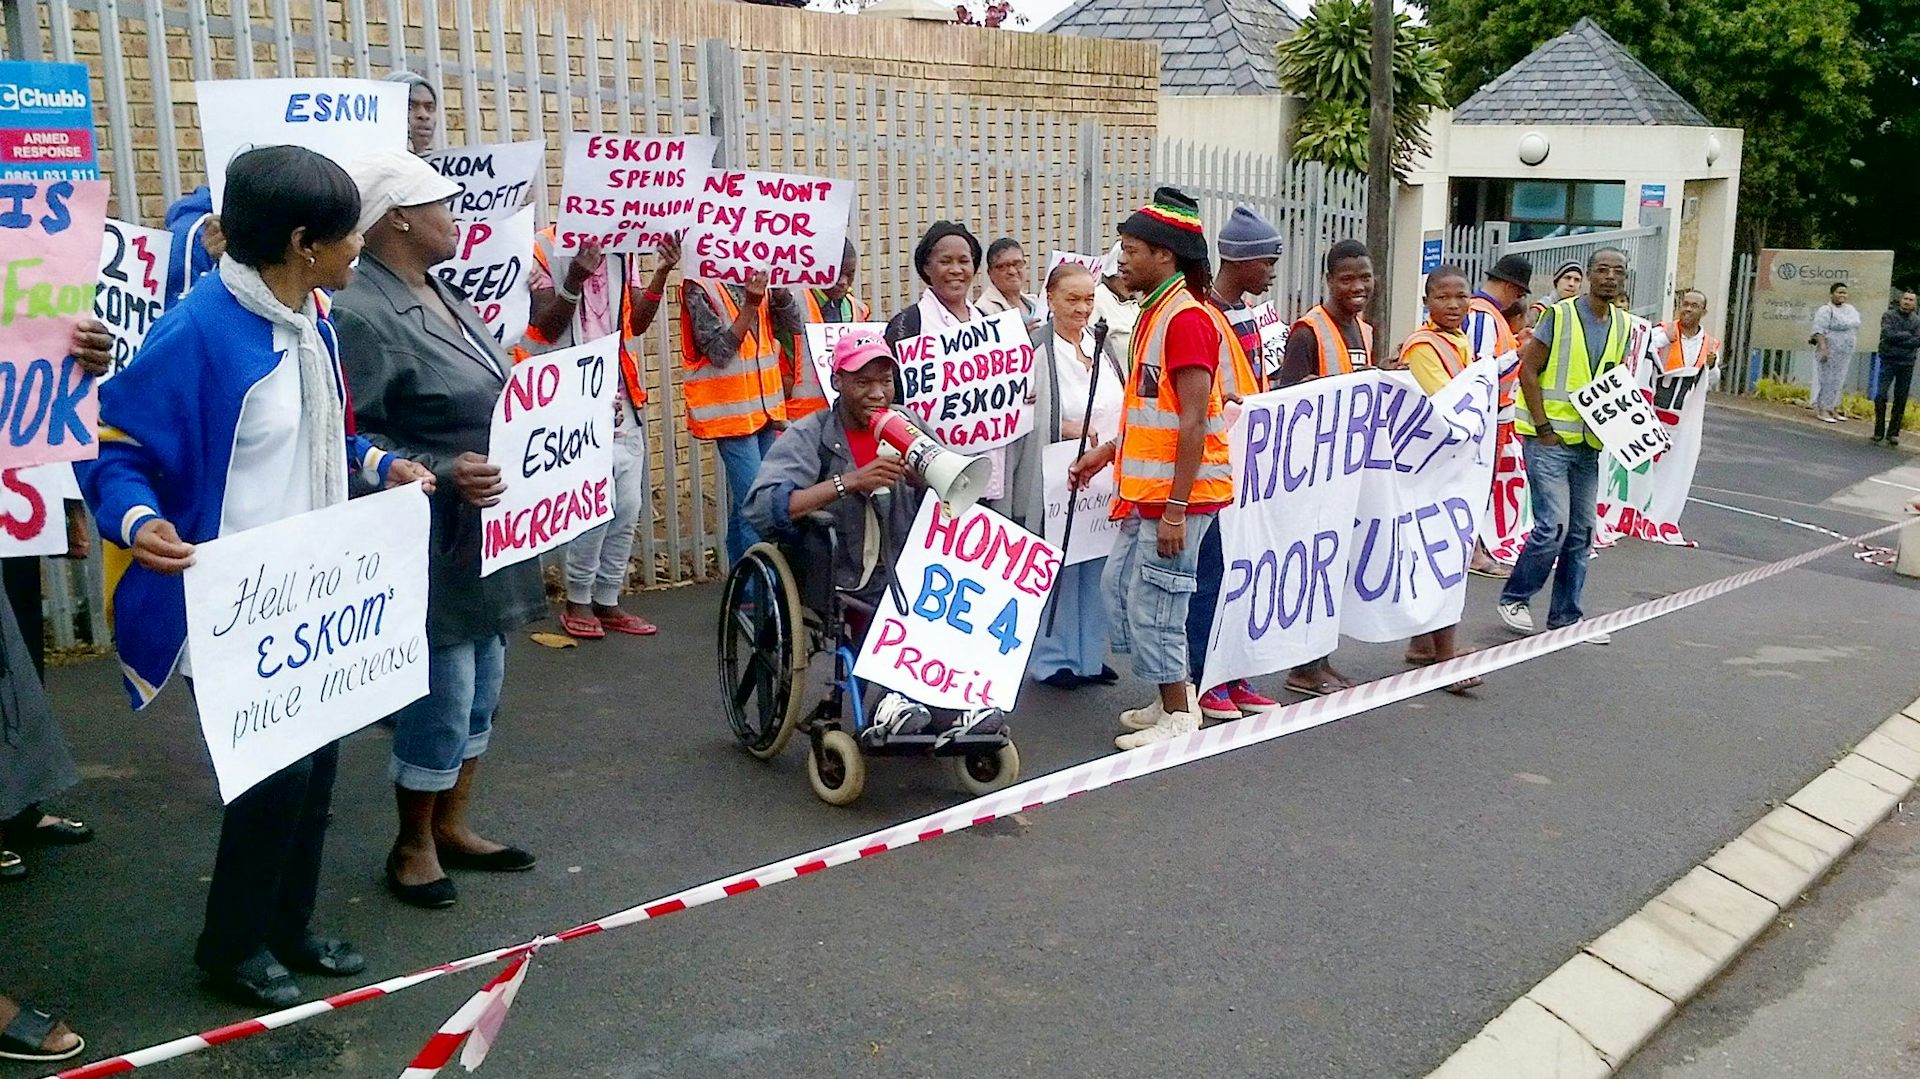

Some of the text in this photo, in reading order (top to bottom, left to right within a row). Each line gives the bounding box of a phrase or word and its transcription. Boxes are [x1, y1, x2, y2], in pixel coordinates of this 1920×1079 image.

[20, 87, 87, 108] Chubb
[285, 93, 378, 123] ESKOM
[13, 145, 82, 158] RESPONSE
[24, 132, 69, 145] ARMED
[587, 136, 685, 162] ESKOM
[607, 168, 686, 188] SPENDS
[757, 178, 832, 202] WONT
[566, 195, 694, 217] R25 MILLION
[697, 201, 817, 238] PAY FOR
[617, 220, 646, 230] ON
[637, 227, 690, 248] PAY
[696, 233, 816, 267] ESKOMS
[438, 256, 520, 302] REED
[770, 265, 835, 285] PLAN
[1799, 264, 1849, 280] Eskom
[898, 319, 1000, 364] WE WONT
[904, 344, 1034, 398] BE ROBBED
[505, 356, 604, 423] NO TO
[940, 377, 1028, 421] ESKOM
[1578, 374, 1623, 407] GIVE
[1240, 389, 1341, 508] RICH
[485, 477, 607, 560] INCREASE
[925, 502, 1061, 597] HOMES
[1214, 530, 1339, 651] POOR
[913, 563, 1021, 655] BE 4
[233, 636, 419, 749] price increase
